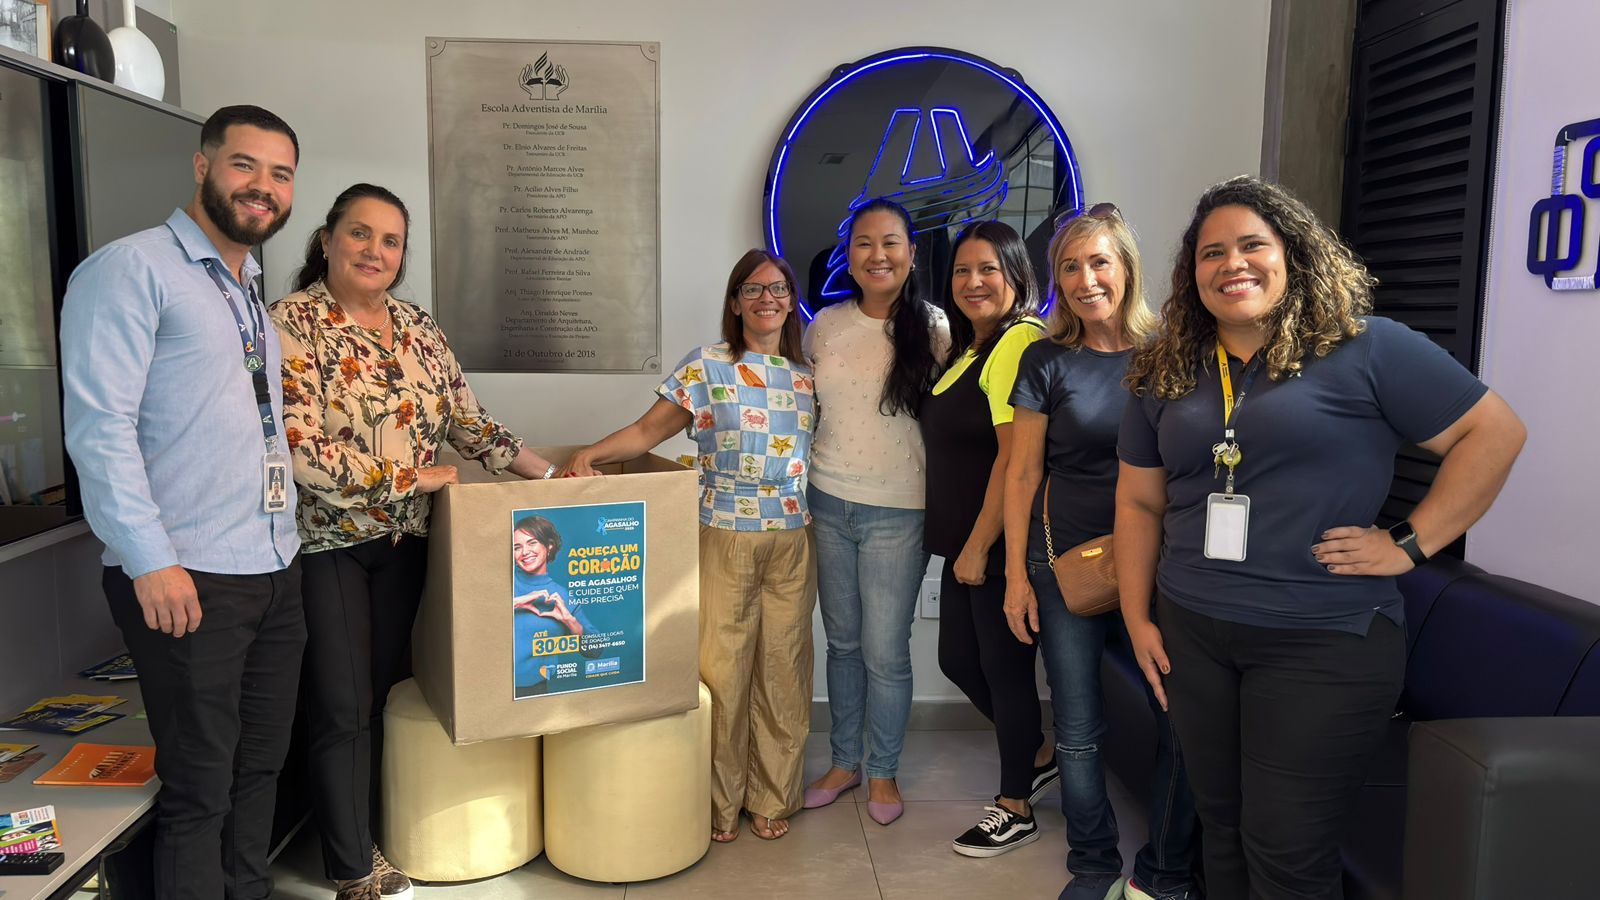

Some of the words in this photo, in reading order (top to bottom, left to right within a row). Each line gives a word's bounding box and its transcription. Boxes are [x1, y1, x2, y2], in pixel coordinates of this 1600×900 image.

[481, 104, 509, 113] Escola
[512, 104, 560, 113] Adventista
[562, 105, 574, 114] de
[545, 123, 559, 131] José
[560, 207, 593, 216] Alvarenga
[512, 226, 540, 234] Matheus
[520, 289, 541, 297] Thiago
[542, 289, 572, 297] Henrique
[500, 325, 534, 333] Engenharia
[540, 325, 573, 333] Construção
[504, 350, 512, 358] 21
[514, 350, 526, 358] de
[527, 350, 563, 358] Outubro
[564, 350, 575, 358] de
[576, 350, 596, 358] 2018
[604, 520, 640, 528] AGASALHO
[568, 545, 619, 559] AQUEÇA
[620, 544, 639, 554] UM
[568, 553, 641, 576] CORAÇÃO
[568, 580, 587, 588] DOE
[588, 575, 638, 587] AGASALHOS
[575, 588, 602, 597] CUIDE
[603, 586, 615, 594] DE
[616, 584, 639, 593] QUEM
[568, 598, 590, 606] MAIS
[591, 594, 625, 604] PRECISA
[533, 630, 549, 638] ATÉ
[581, 632, 607, 640] CONSULTE
